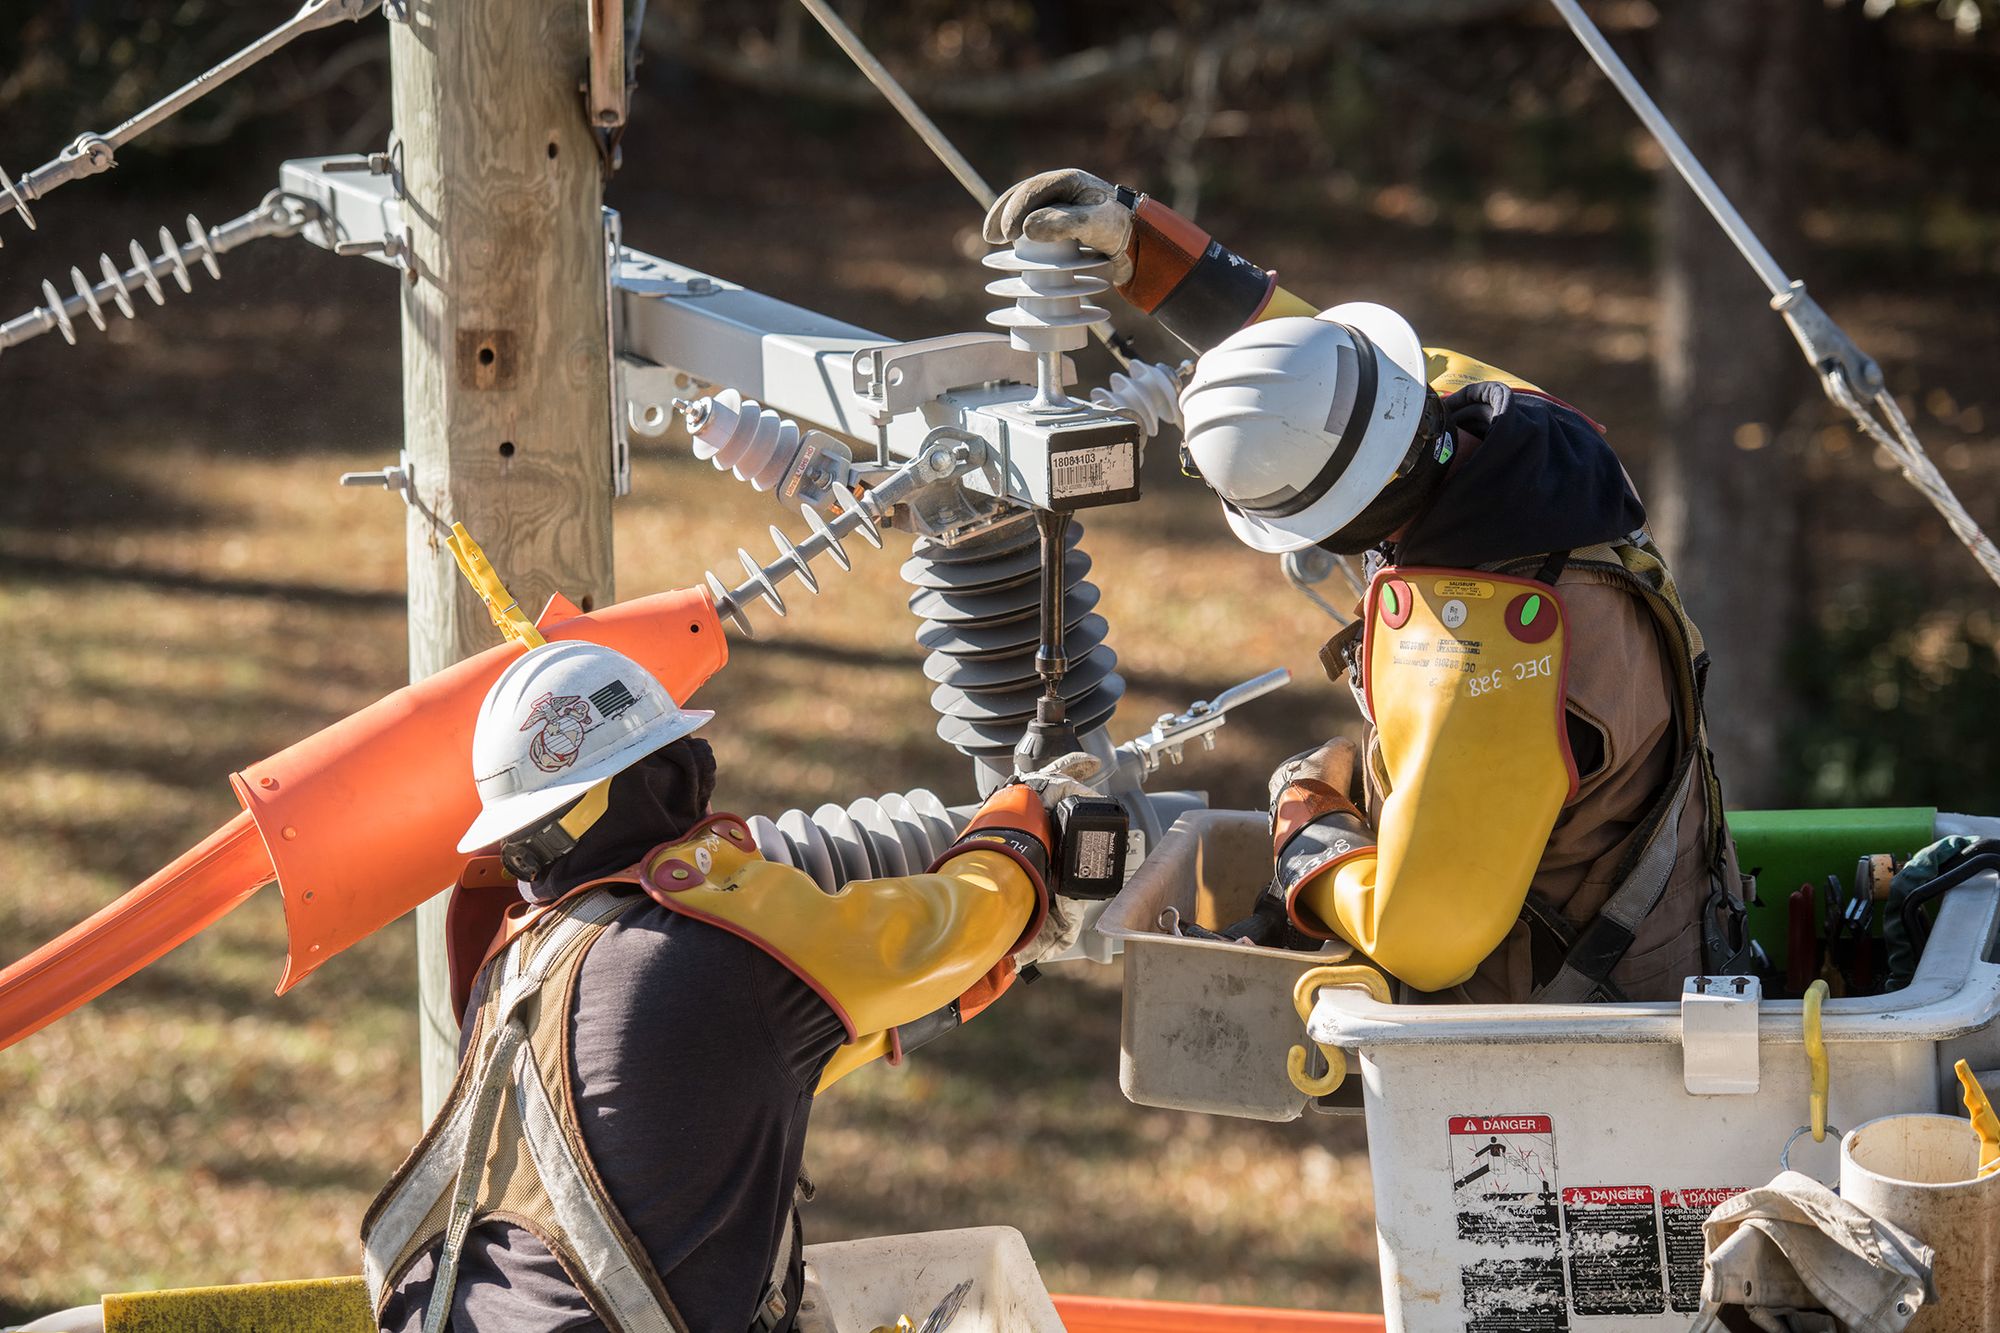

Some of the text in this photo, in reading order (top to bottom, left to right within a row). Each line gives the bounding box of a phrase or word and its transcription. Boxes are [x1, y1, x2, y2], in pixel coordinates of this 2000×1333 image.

[1469, 654, 1552, 697] DEC 328
[1010, 840, 1029, 854] 74
[1483, 1119, 1536, 1131] DANGER
[1590, 1189, 1645, 1201] DANGER
[1513, 1208, 1547, 1216] HAZARDS
